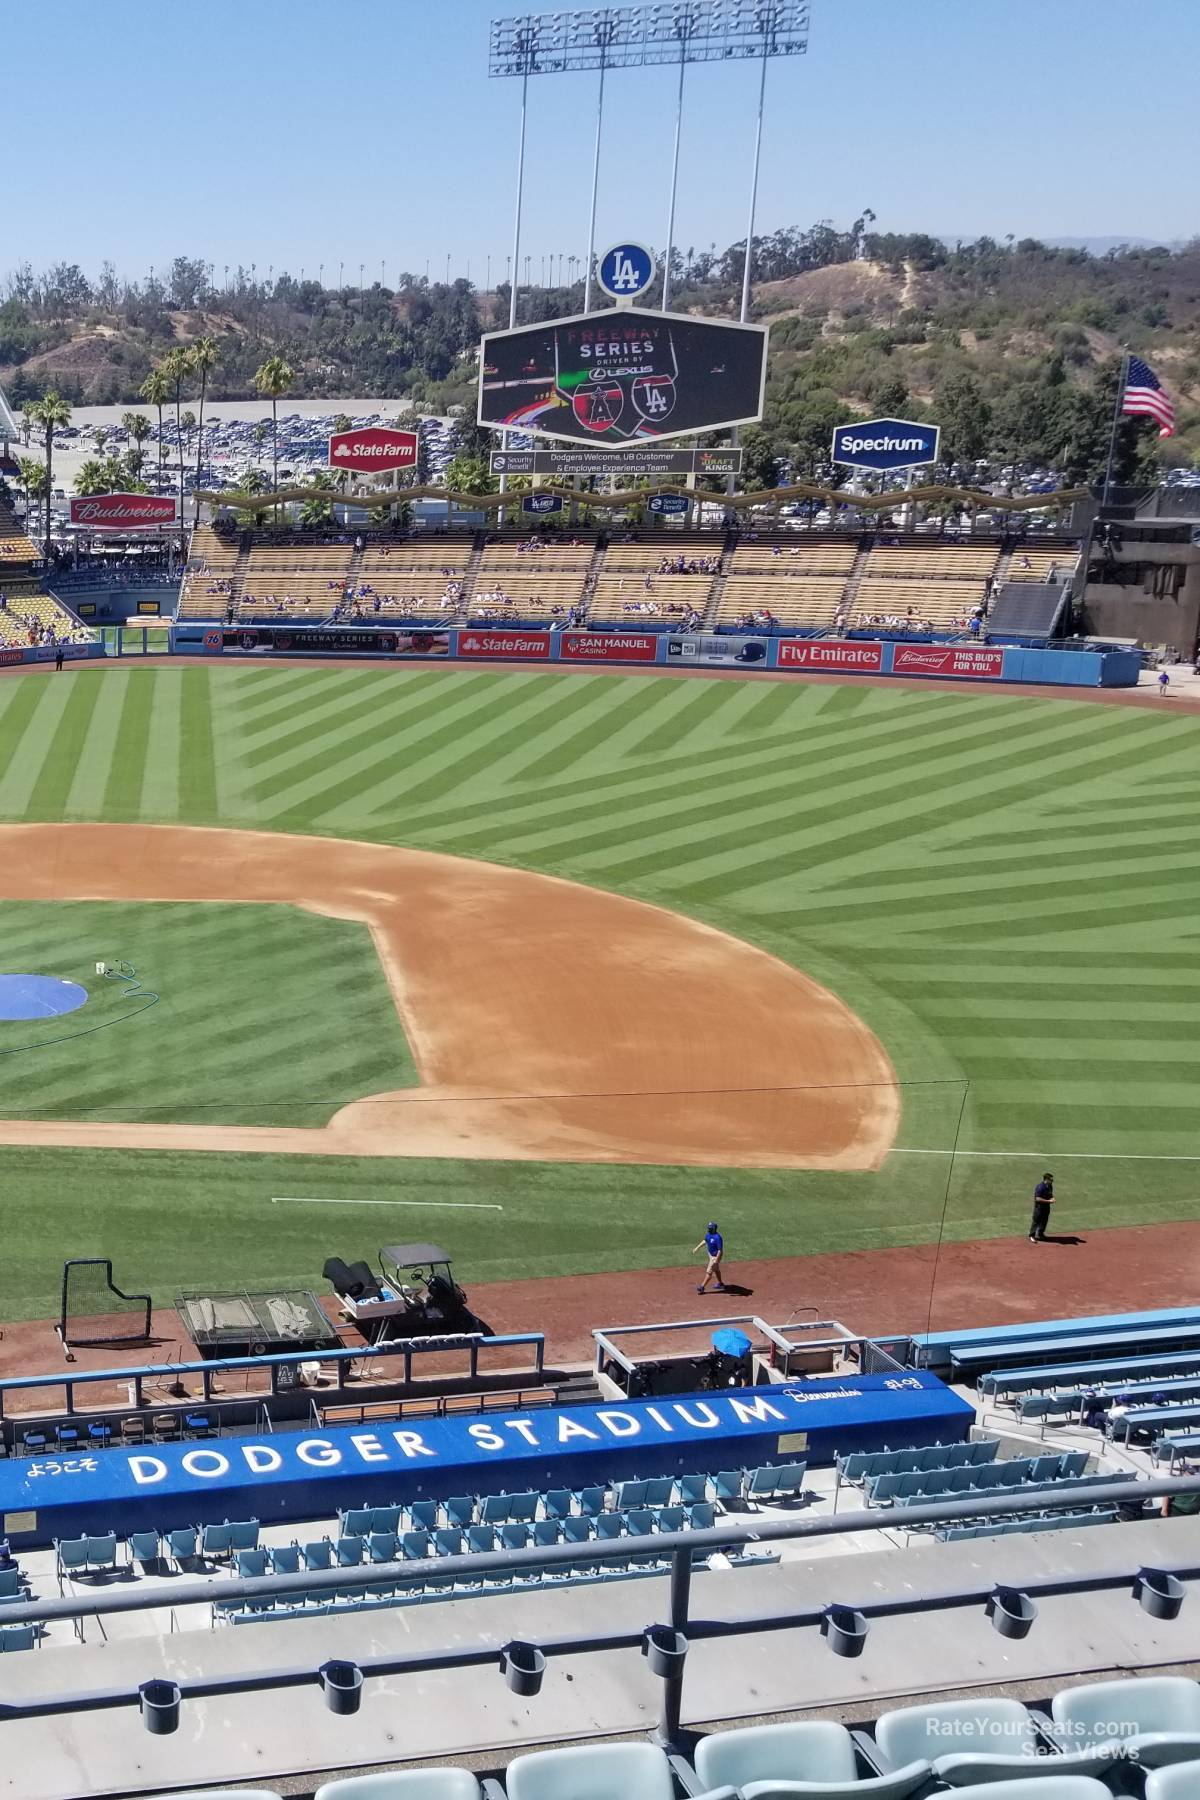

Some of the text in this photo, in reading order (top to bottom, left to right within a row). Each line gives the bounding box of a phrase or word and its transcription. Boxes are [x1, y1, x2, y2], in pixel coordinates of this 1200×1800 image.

[612, 251, 639, 289] LA
[567, 327, 661, 344] FREEWAY
[580, 341, 654, 357] SERIES
[597, 357, 629, 365] DRIVEN
[607, 365, 653, 377] LEXUS
[643, 383, 667, 413] LA
[841, 436, 923, 454] Spectrum
[507, 456, 533, 466] Security
[551, 453, 583, 463] Dodgers
[584, 453, 622, 462] Welcome,
[636, 453, 674, 461] Customer
[564, 464, 601, 473] Employee
[602, 464, 646, 473] Experience
[75, 503, 173, 520] Budweiser
[207, 635, 219, 644] 76
[579, 638, 650, 649] SAN MANUEL
[782, 646, 879, 663] Fly Emirates
[903, 653, 945, 663] Budweiser
[955, 652, 1002, 662] THIS BUD'S
[953, 662, 992, 671] FOR YOU.
[127, 1395, 787, 1486] DODGER STADIUM
[26, 1458, 99, 1478] ようこそ
